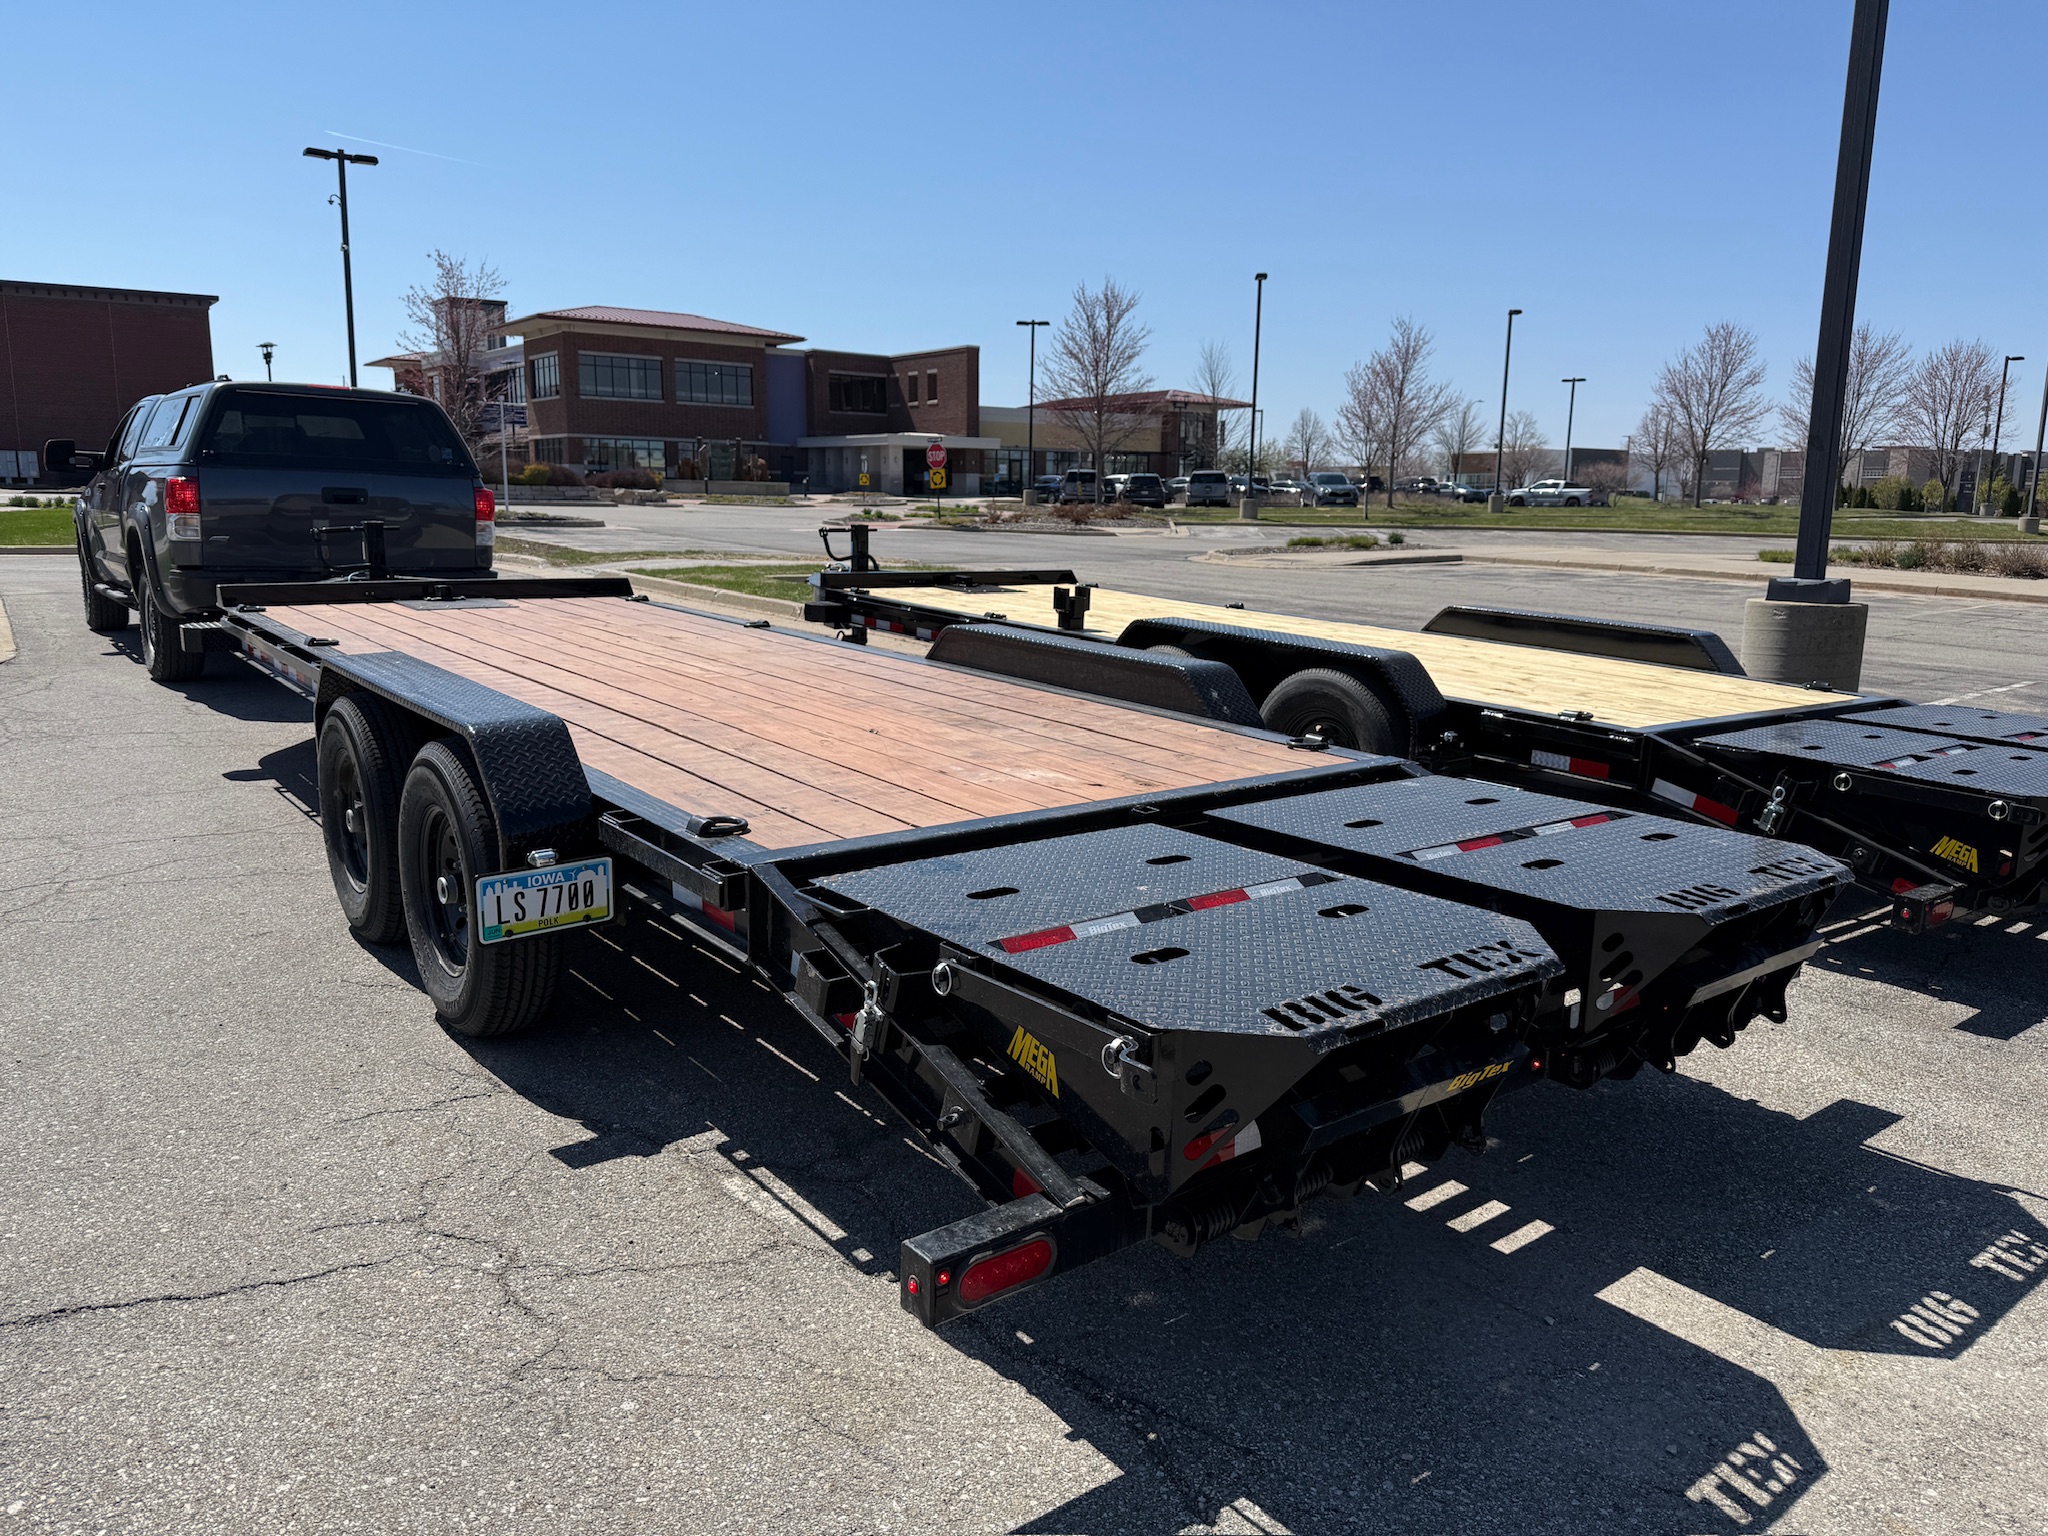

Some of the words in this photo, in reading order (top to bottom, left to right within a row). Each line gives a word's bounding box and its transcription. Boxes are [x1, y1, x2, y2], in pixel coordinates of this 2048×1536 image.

[928, 450, 945, 461] STOP
[1929, 835, 1979, 873] MEGA
[1947, 856, 1967, 866] RAMP
[527, 871, 565, 888] IOWA
[1655, 883, 1742, 911] BIG
[1746, 856, 1836, 880] TEX
[496, 890, 526, 925] LS
[537, 879, 594, 918] 7700
[487, 927, 501, 935] JUN
[538, 917, 559, 927] POLK
[1261, 985, 1383, 1032] BIG
[1417, 940, 1543, 980] TEX
[1006, 1024, 1060, 1100] MEGA
[1025, 1062, 1047, 1085] RAMP
